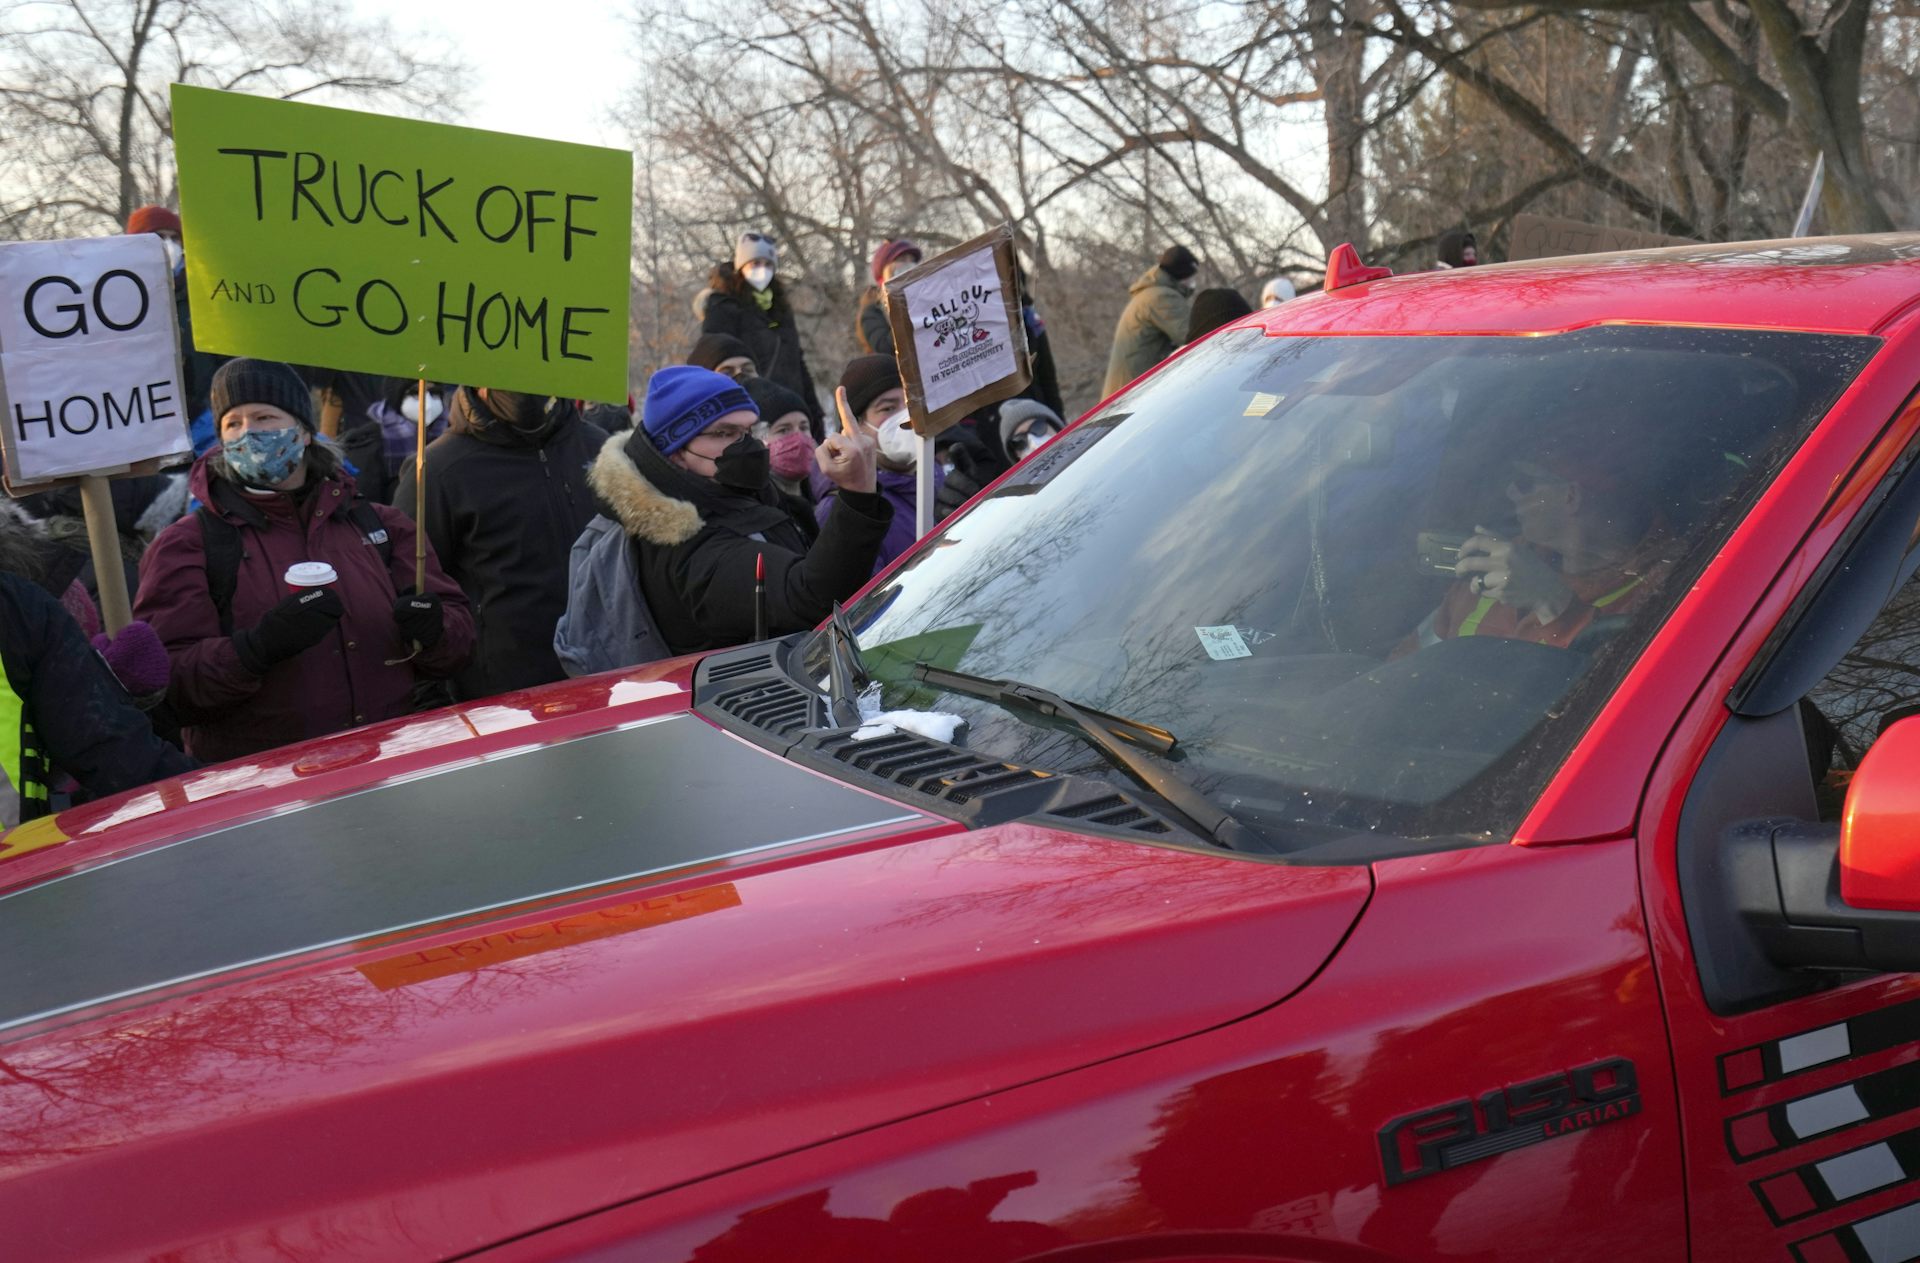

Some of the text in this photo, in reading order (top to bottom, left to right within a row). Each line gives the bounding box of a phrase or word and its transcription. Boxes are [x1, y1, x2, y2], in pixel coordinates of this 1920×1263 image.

[217, 147, 599, 261] TRUCK OFF
[23, 268, 150, 339] GO
[210, 267, 610, 362] AND GO HOME
[923, 299, 959, 329] CALL
[961, 285, 992, 304] OUT
[931, 373, 940, 383] IN
[940, 364, 961, 378] YOUR
[961, 343, 1004, 368] COMMUNITY
[15, 380, 177, 442] HOME
[299, 589, 324, 604] KOMBI
[1542, 1099, 1633, 1137] LARIAT
